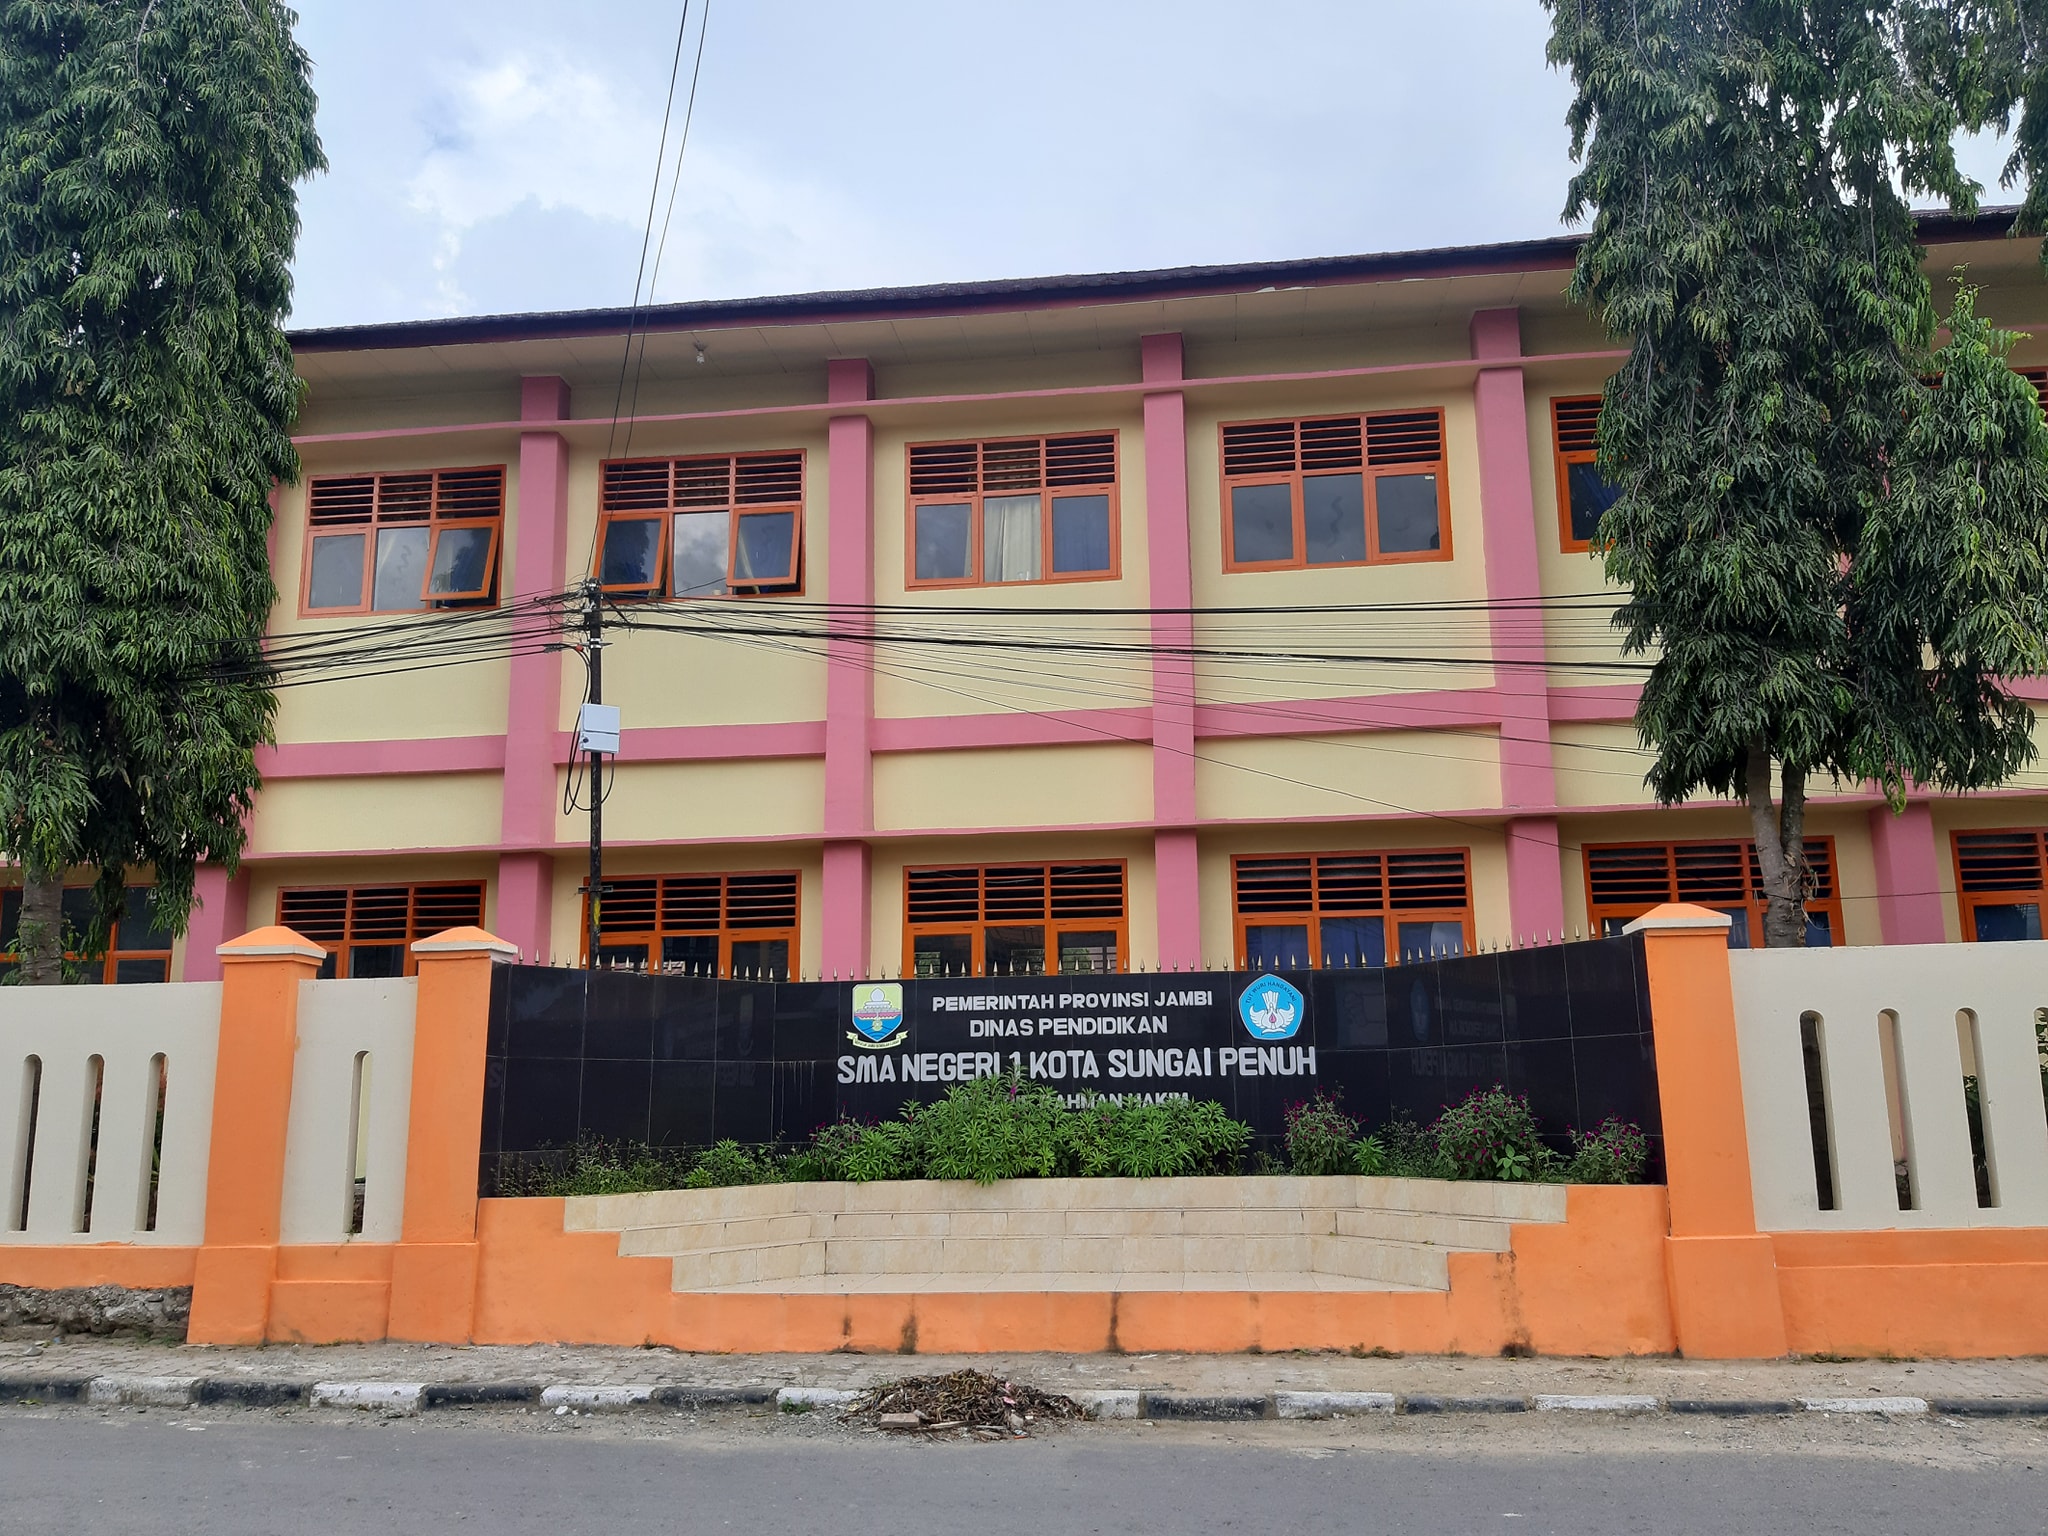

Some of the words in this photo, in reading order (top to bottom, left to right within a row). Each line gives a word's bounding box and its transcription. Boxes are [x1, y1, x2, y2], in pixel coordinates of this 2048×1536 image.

[932, 994, 1055, 1012] PEMERINTAH
[1059, 992, 1149, 1009] PROVINSI
[1154, 990, 1213, 1007] JAMBI
[1245, 993, 1254, 1004] TUT
[969, 1018, 1034, 1038] DINAS
[1038, 1015, 1168, 1036] PENDIDIKAN
[837, 1054, 897, 1084] SMA
[901, 1051, 1000, 1082] NEGERI
[1007, 1050, 1020, 1079] 1
[1028, 1049, 1100, 1079] KOTA
[1107, 1047, 1212, 1078] SUNGAI
[1219, 1045, 1318, 1077] PENUH
